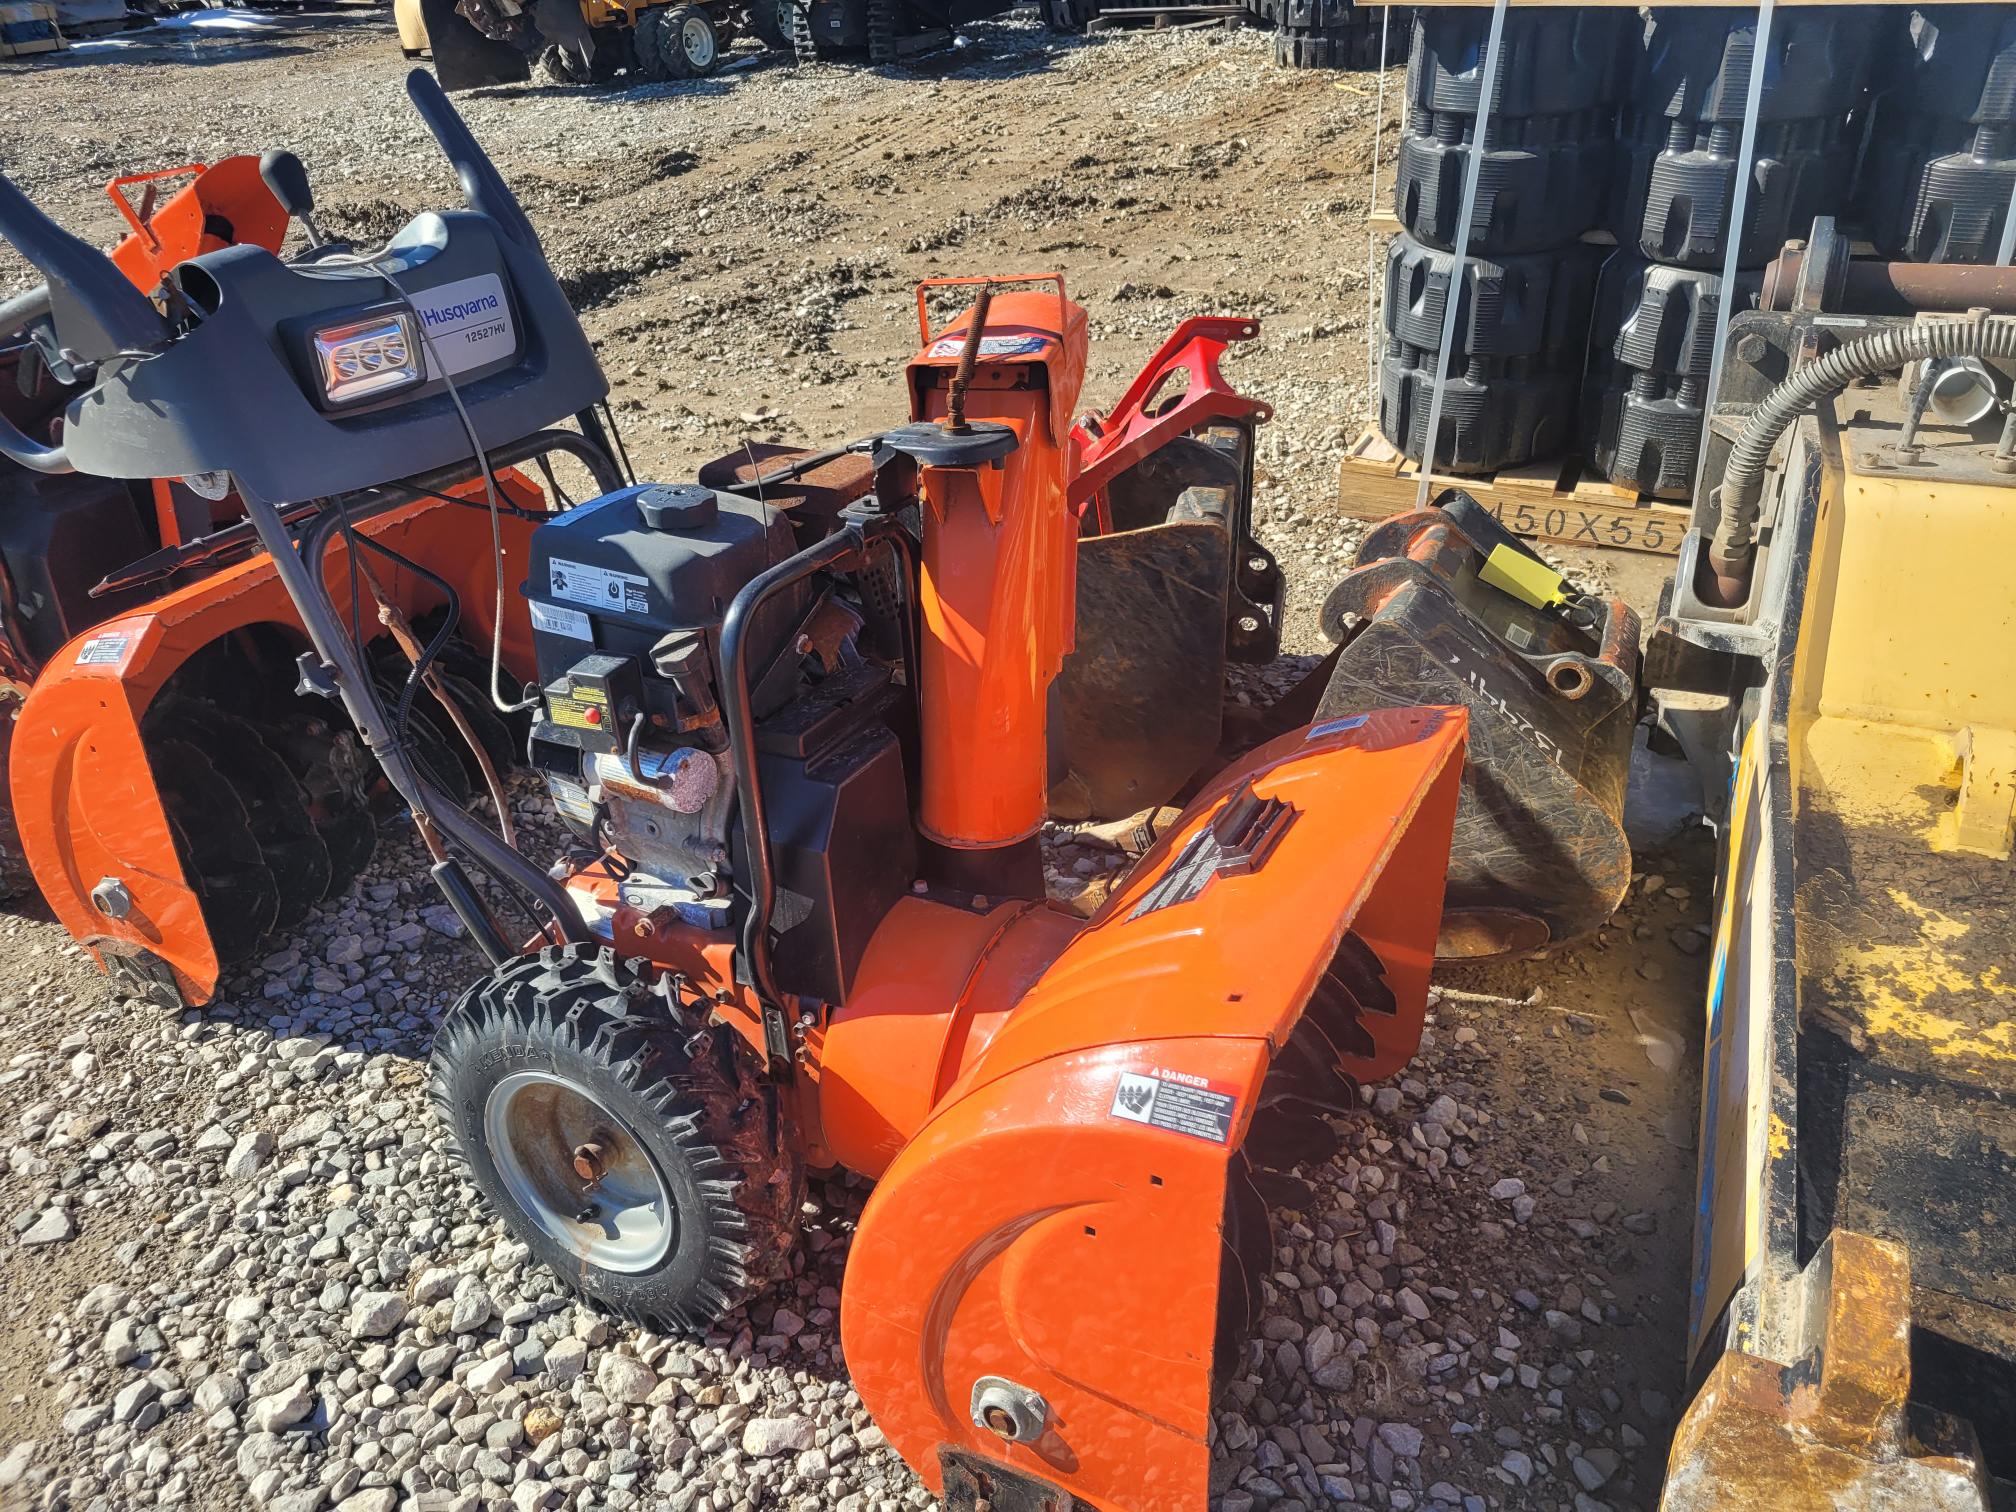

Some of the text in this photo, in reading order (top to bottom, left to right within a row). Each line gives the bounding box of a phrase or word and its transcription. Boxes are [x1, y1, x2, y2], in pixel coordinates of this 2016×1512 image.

[423, 294, 498, 327] Husqvarna
[465, 322, 506, 343] 12527HV
[480, 1045, 539, 1069] KENDA
[1161, 1068, 1209, 1088] DANGER
